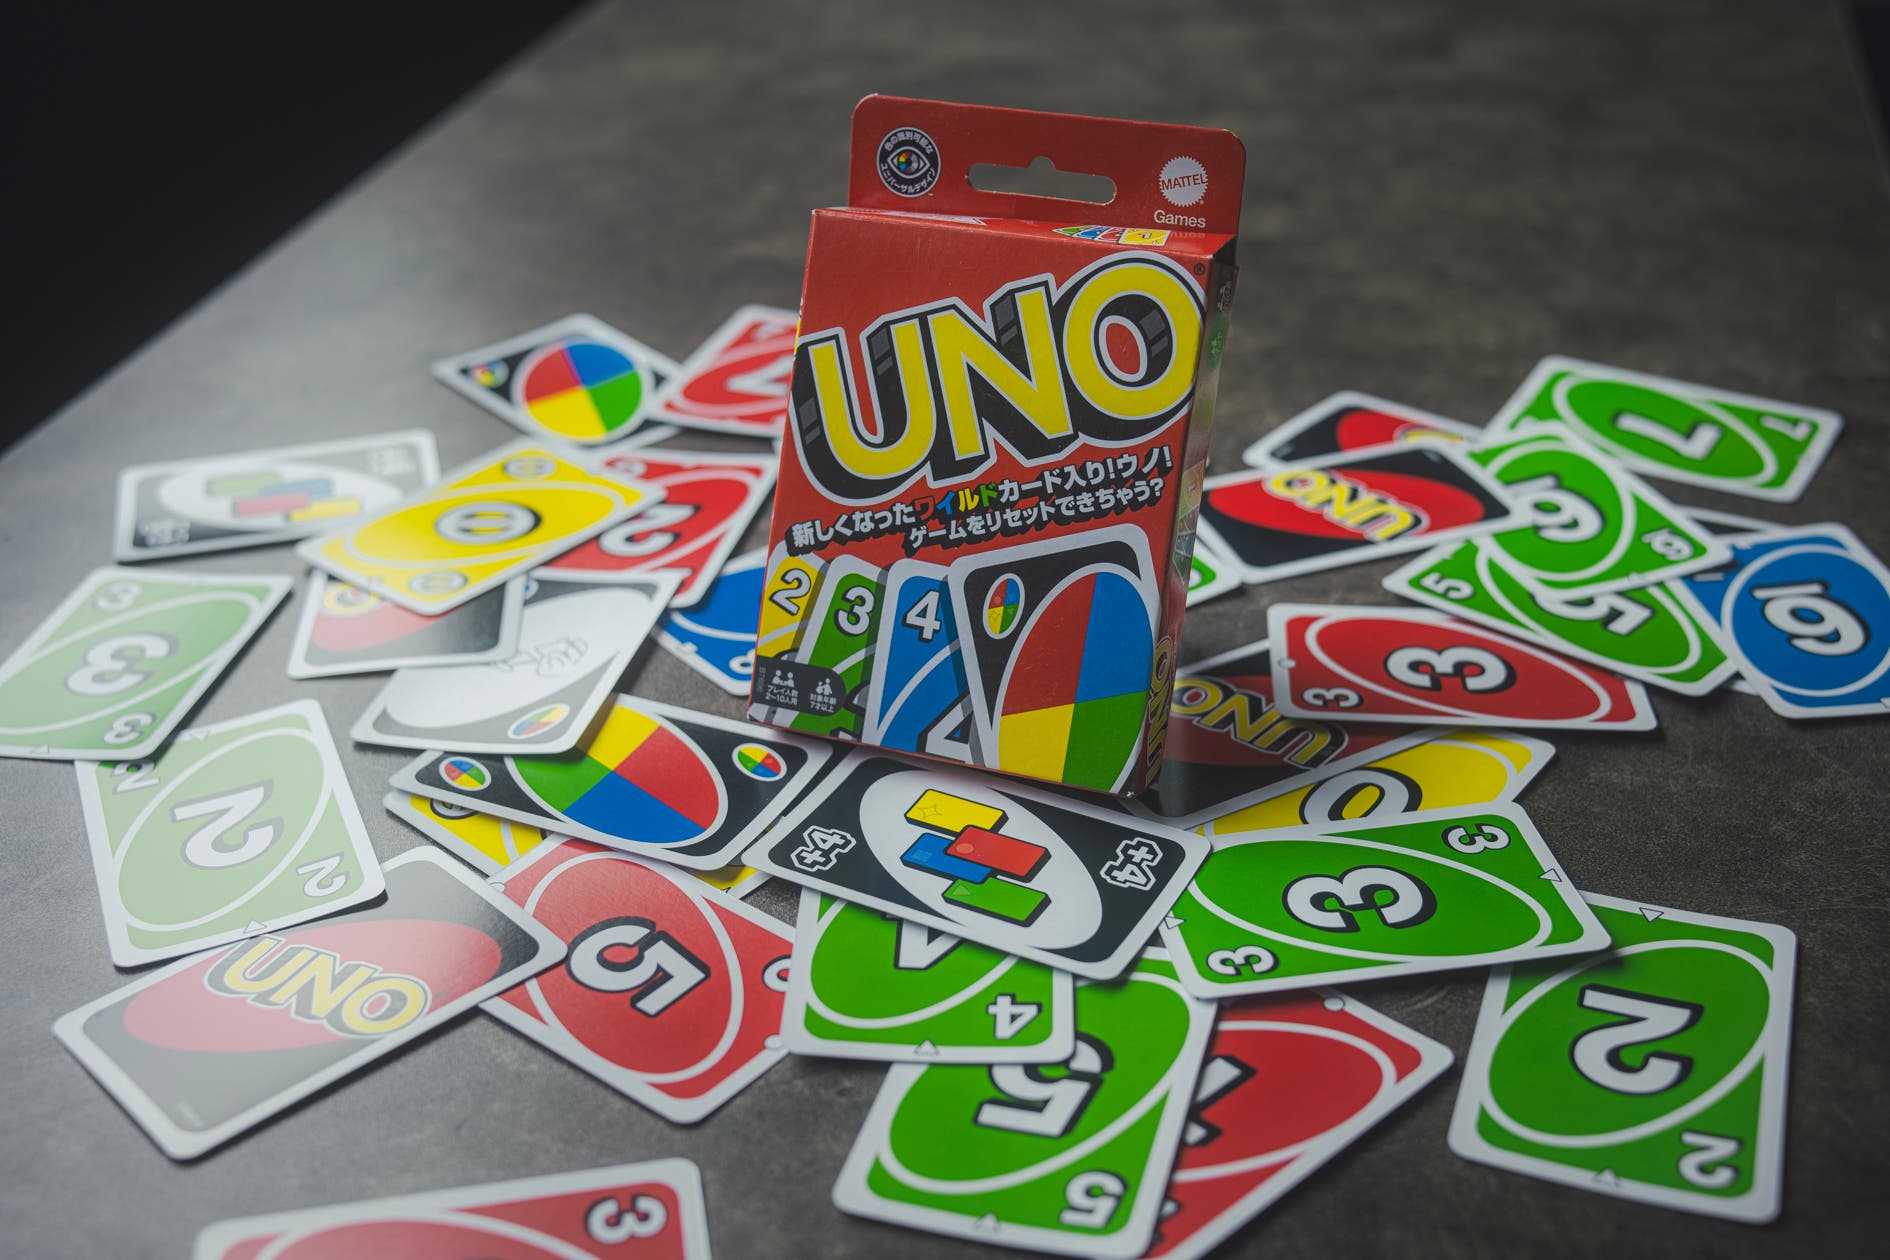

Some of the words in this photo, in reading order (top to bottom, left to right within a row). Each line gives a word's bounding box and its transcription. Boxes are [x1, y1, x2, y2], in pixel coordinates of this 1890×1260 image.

[1161, 172, 1208, 191] MATTEL
[1153, 209, 1207, 229] Games
[796, 256, 1205, 500] UNO
[1262, 469, 1430, 543] UNO
[771, 568, 812, 616] 2
[834, 584, 877, 638] 3
[1419, 572, 1475, 600] 5
[904, 589, 943, 643] 4
[64, 633, 178, 696] 3
[1384, 646, 1516, 695] 3
[1171, 675, 1349, 769] UNO
[1303, 686, 1363, 709] 3
[102, 712, 156, 745] 3
[170, 778, 284, 870] 2
[1440, 822, 1511, 855] 3
[297, 853, 350, 899] 2
[1281, 865, 1438, 934] 3
[205, 935, 431, 1038] UNO
[565, 916, 711, 1018] 5
[1206, 944, 1279, 977] 3
[986, 993, 1043, 1040] 4
[1568, 984, 1705, 1096] 2
[1676, 1130, 1743, 1189] 2
[585, 1194, 668, 1245] 3
[1058, 1169, 1128, 1229] 5
